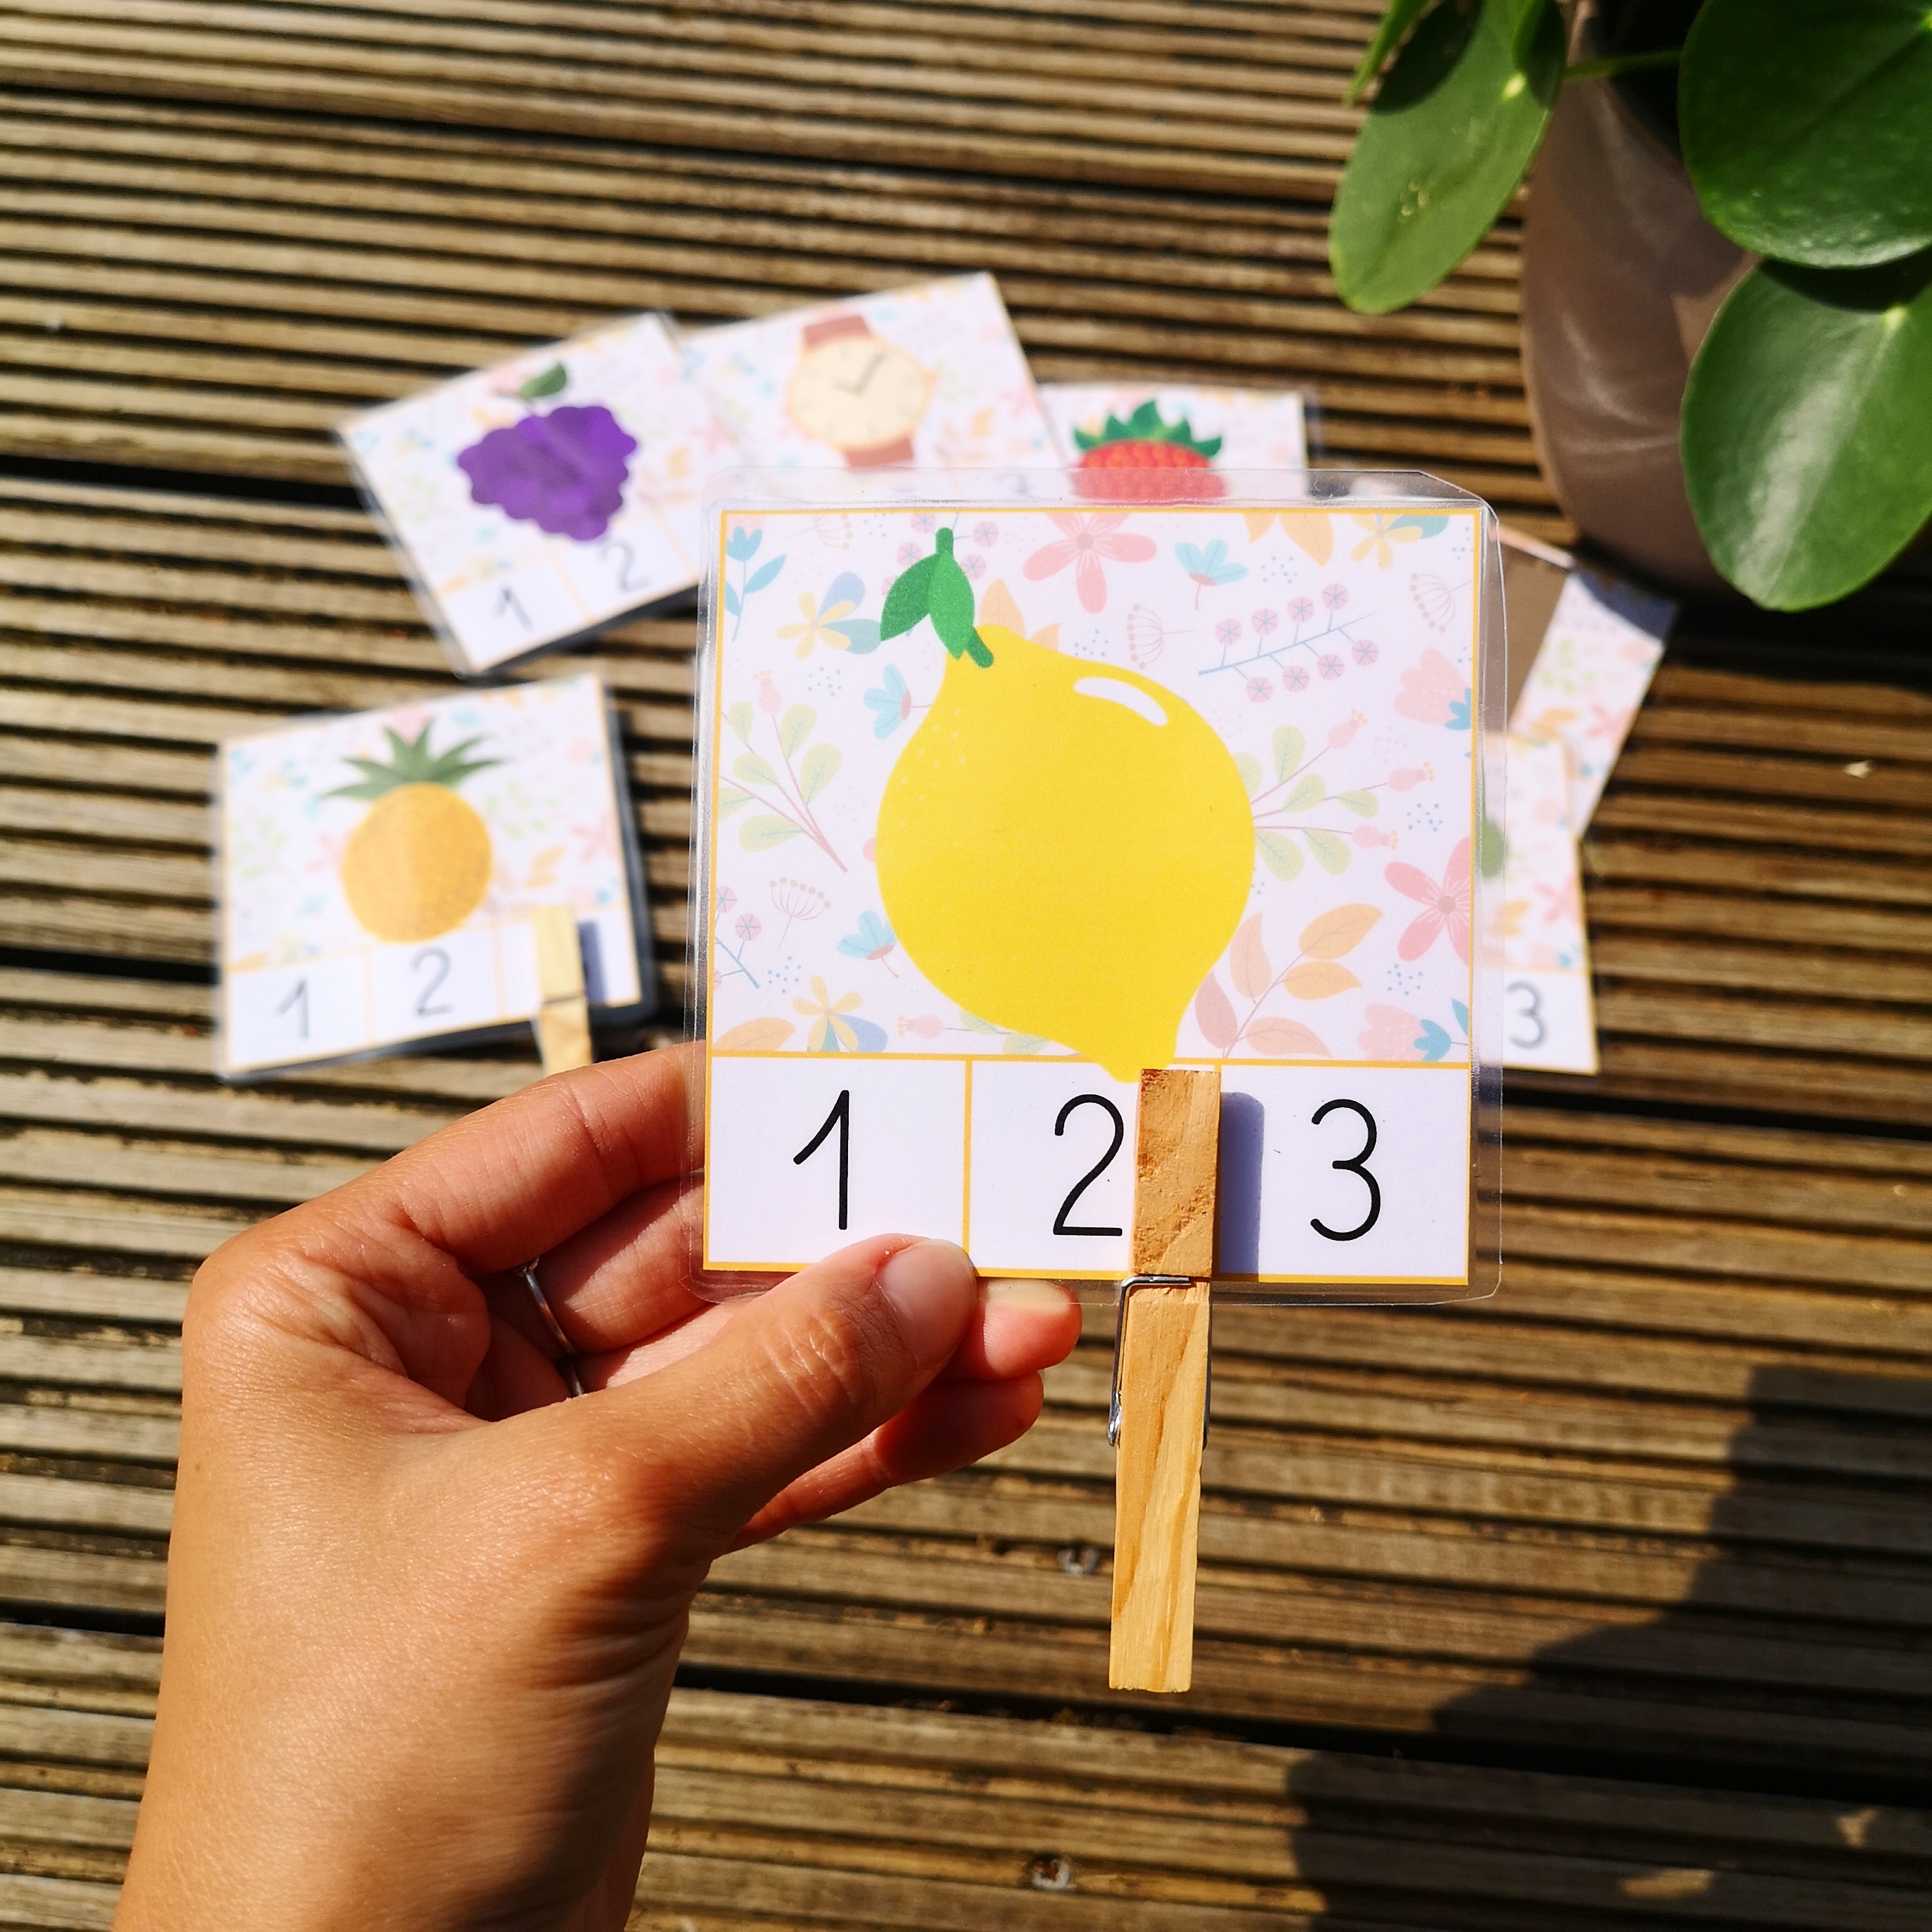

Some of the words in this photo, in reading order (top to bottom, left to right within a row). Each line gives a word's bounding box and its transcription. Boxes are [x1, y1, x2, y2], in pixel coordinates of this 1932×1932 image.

[491, 583, 533, 633] 1
[597, 535, 651, 593] 2
[276, 974, 311, 1041] 1
[411, 946, 453, 1018] 2
[1505, 980, 1549, 1050] 3
[793, 1090, 849, 1231] 1
[1052, 1094, 1124, 1236] 2
[1310, 1099, 1381, 1241] 3
